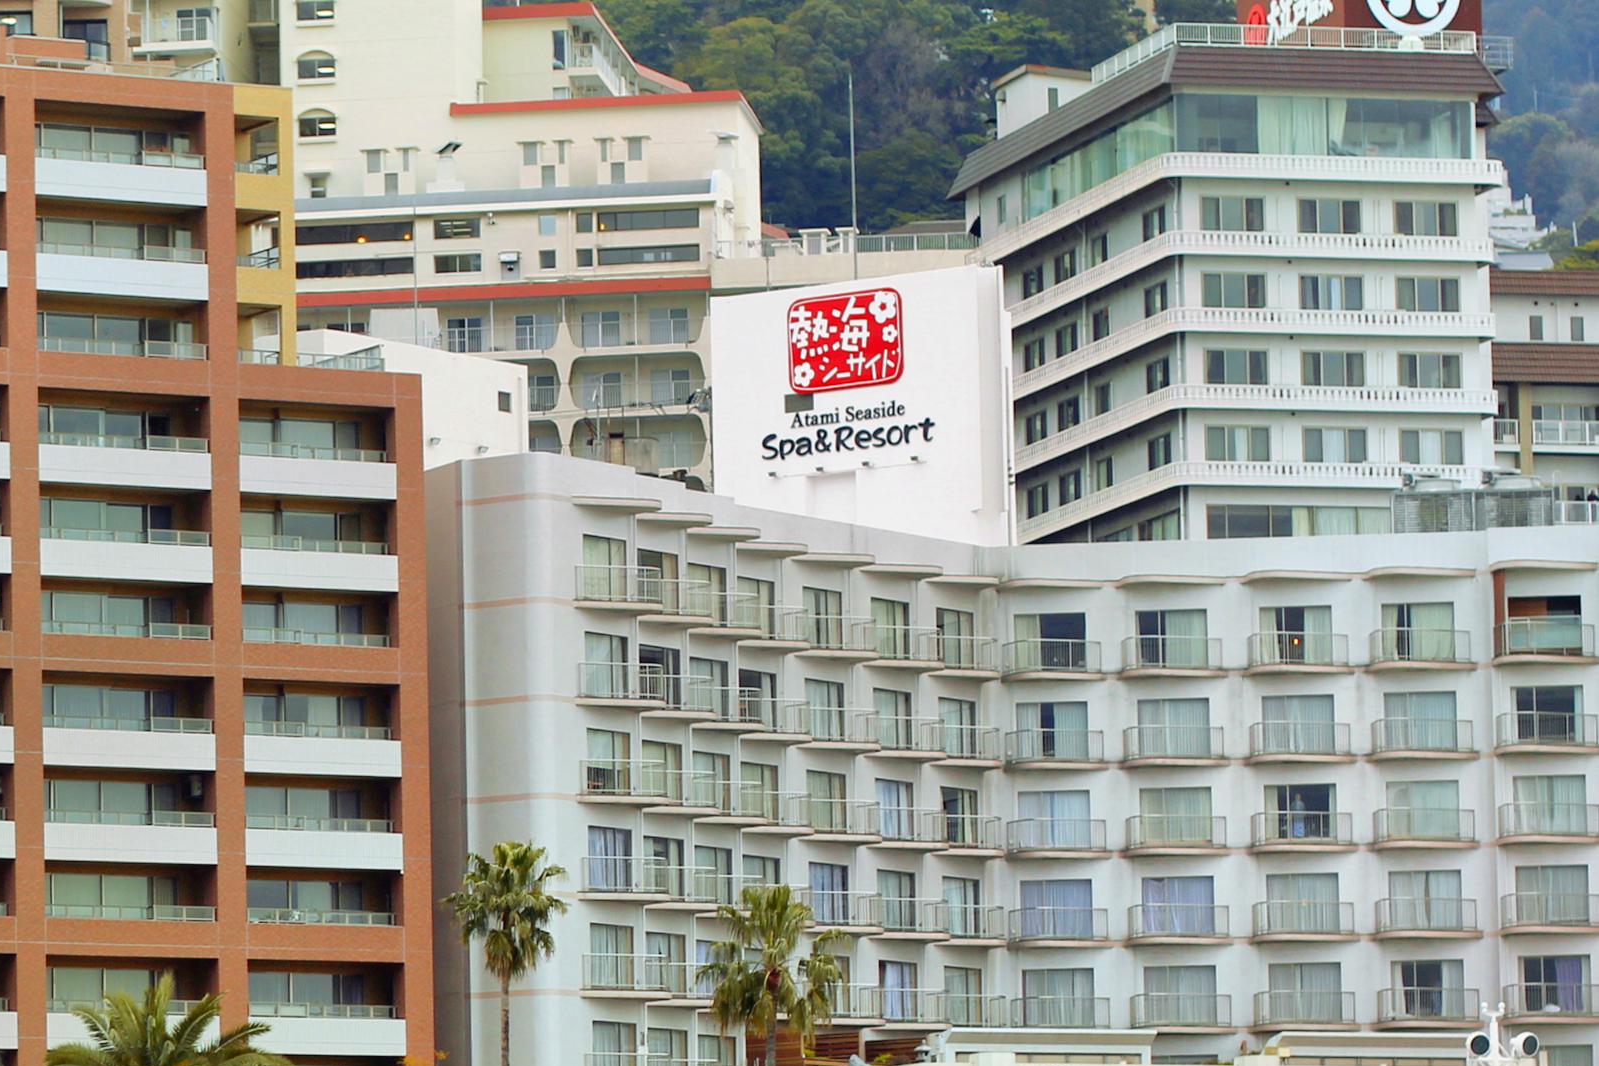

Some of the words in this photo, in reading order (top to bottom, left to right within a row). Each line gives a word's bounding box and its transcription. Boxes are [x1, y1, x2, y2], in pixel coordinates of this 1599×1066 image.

[789, 296, 870, 360] 熱海
[819, 347, 900, 383] シーサイド
[790, 407, 840, 429] Atami
[845, 400, 906, 423] Seaside
[761, 417, 936, 461] Spa&Resort
